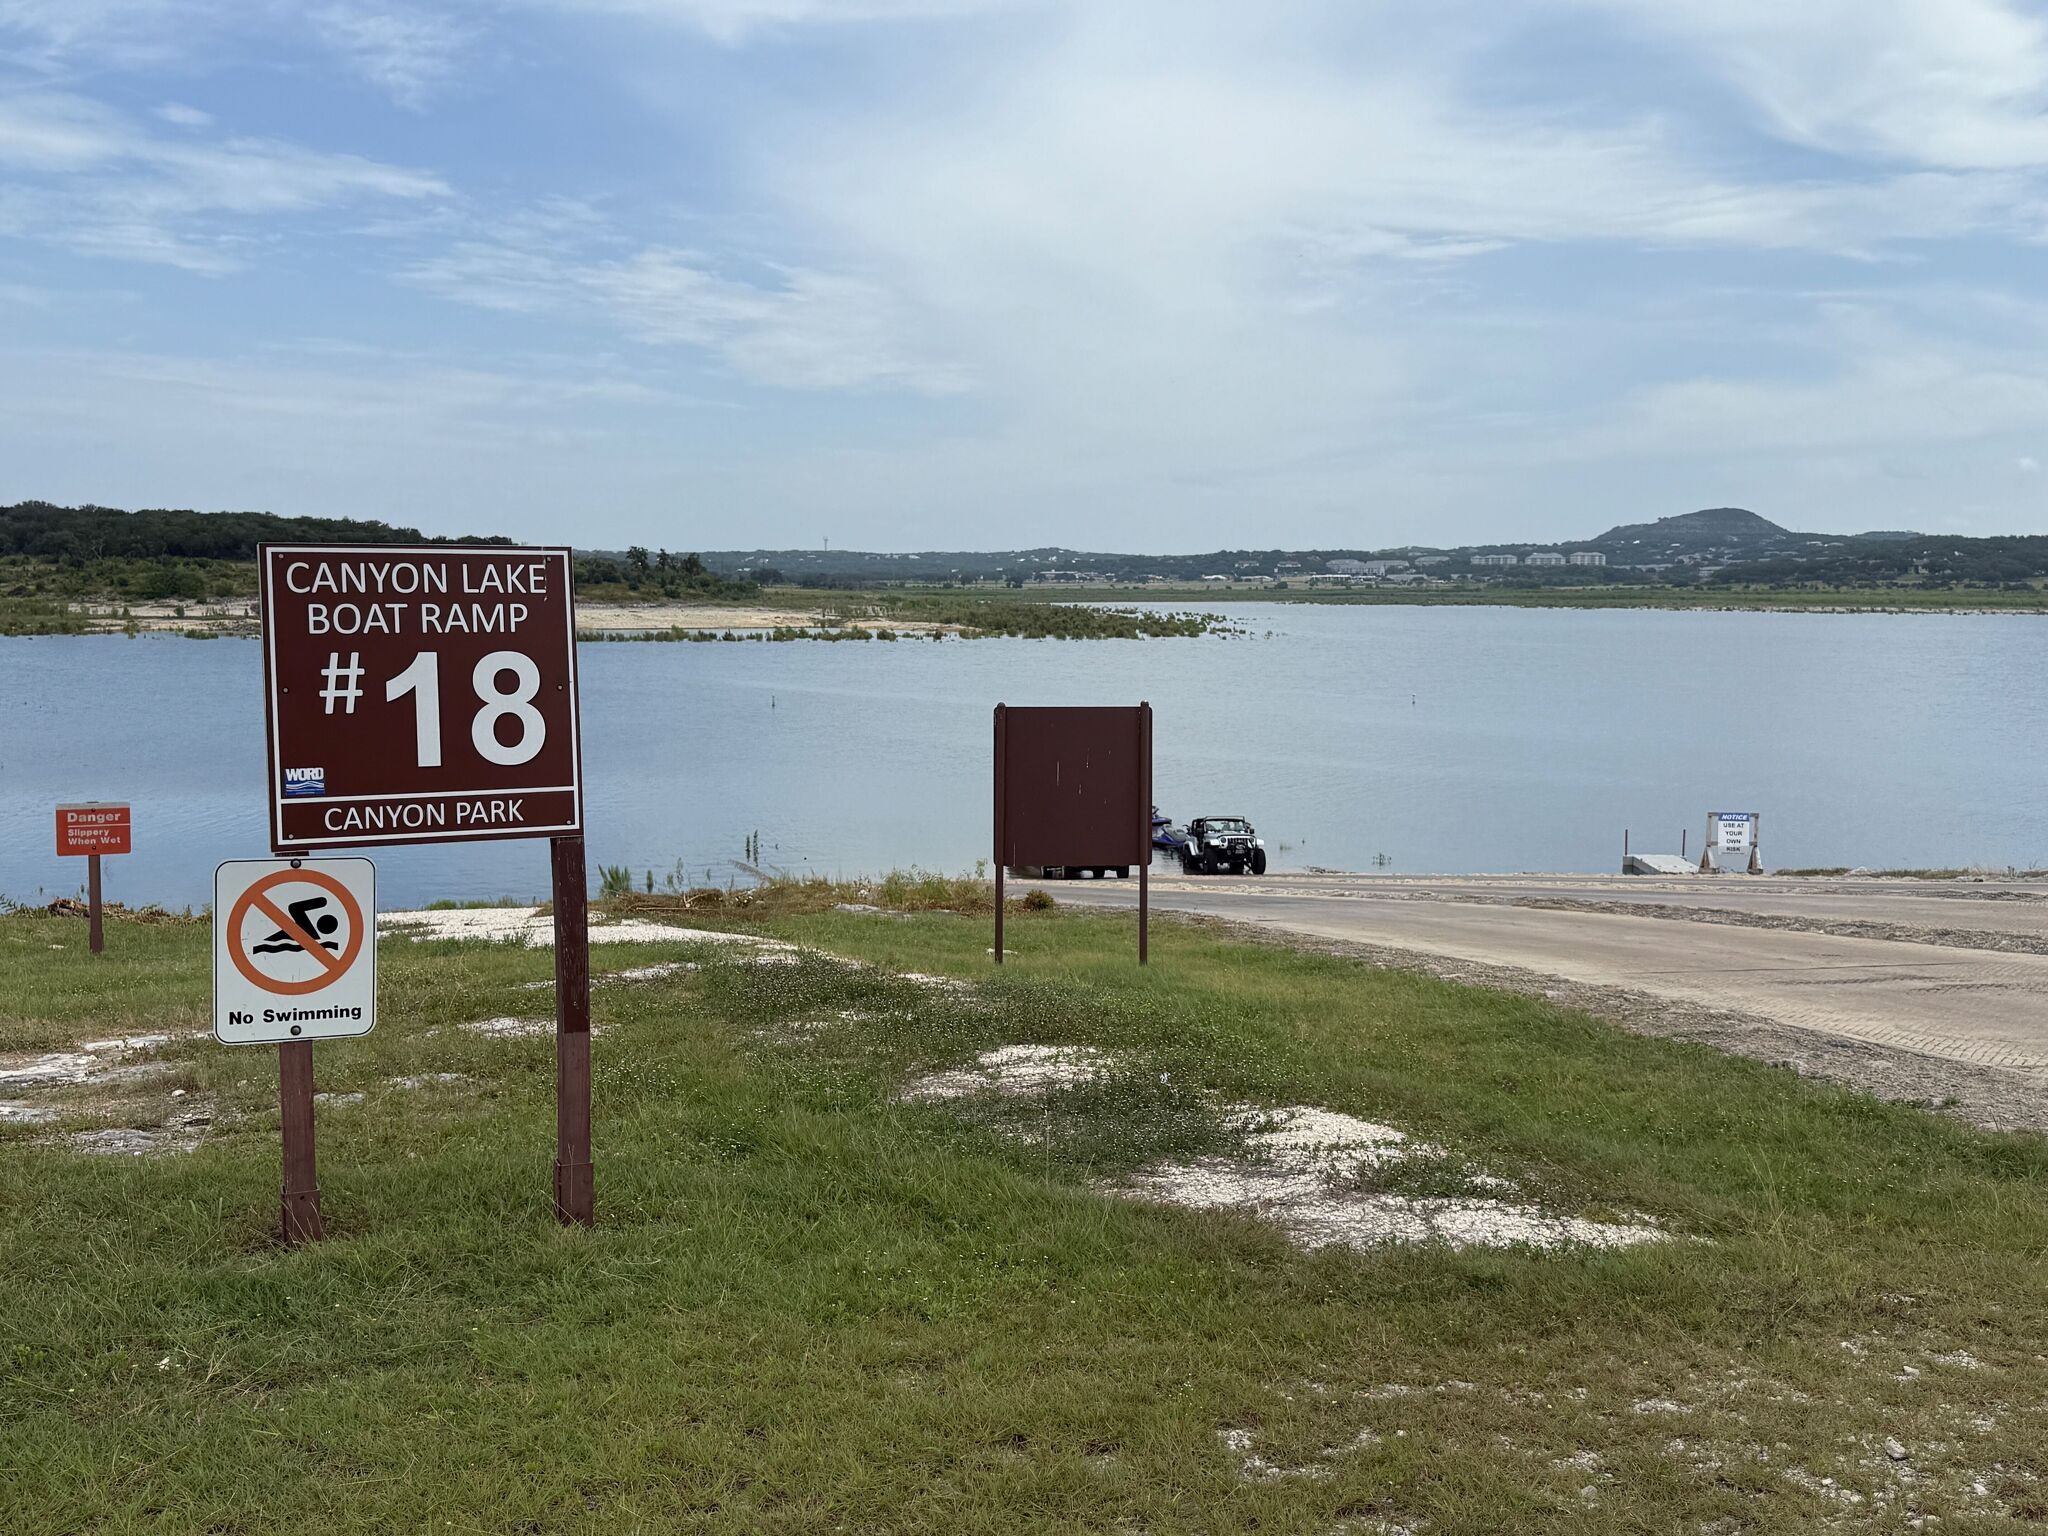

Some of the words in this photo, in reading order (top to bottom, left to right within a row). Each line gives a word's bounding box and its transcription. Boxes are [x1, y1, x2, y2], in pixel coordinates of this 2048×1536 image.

[286, 562, 448, 594] CANYON
[462, 563, 546, 594] LAKE
[308, 603, 408, 634] BOAT
[421, 603, 528, 633] RAMP
[67, 813, 120, 823] Danger
[324, 804, 445, 831] CANYON
[456, 799, 524, 824] PARK
[68, 829, 109, 837] Slippery
[229, 1012, 253, 1025] No
[263, 1005, 362, 1023] Swimming
